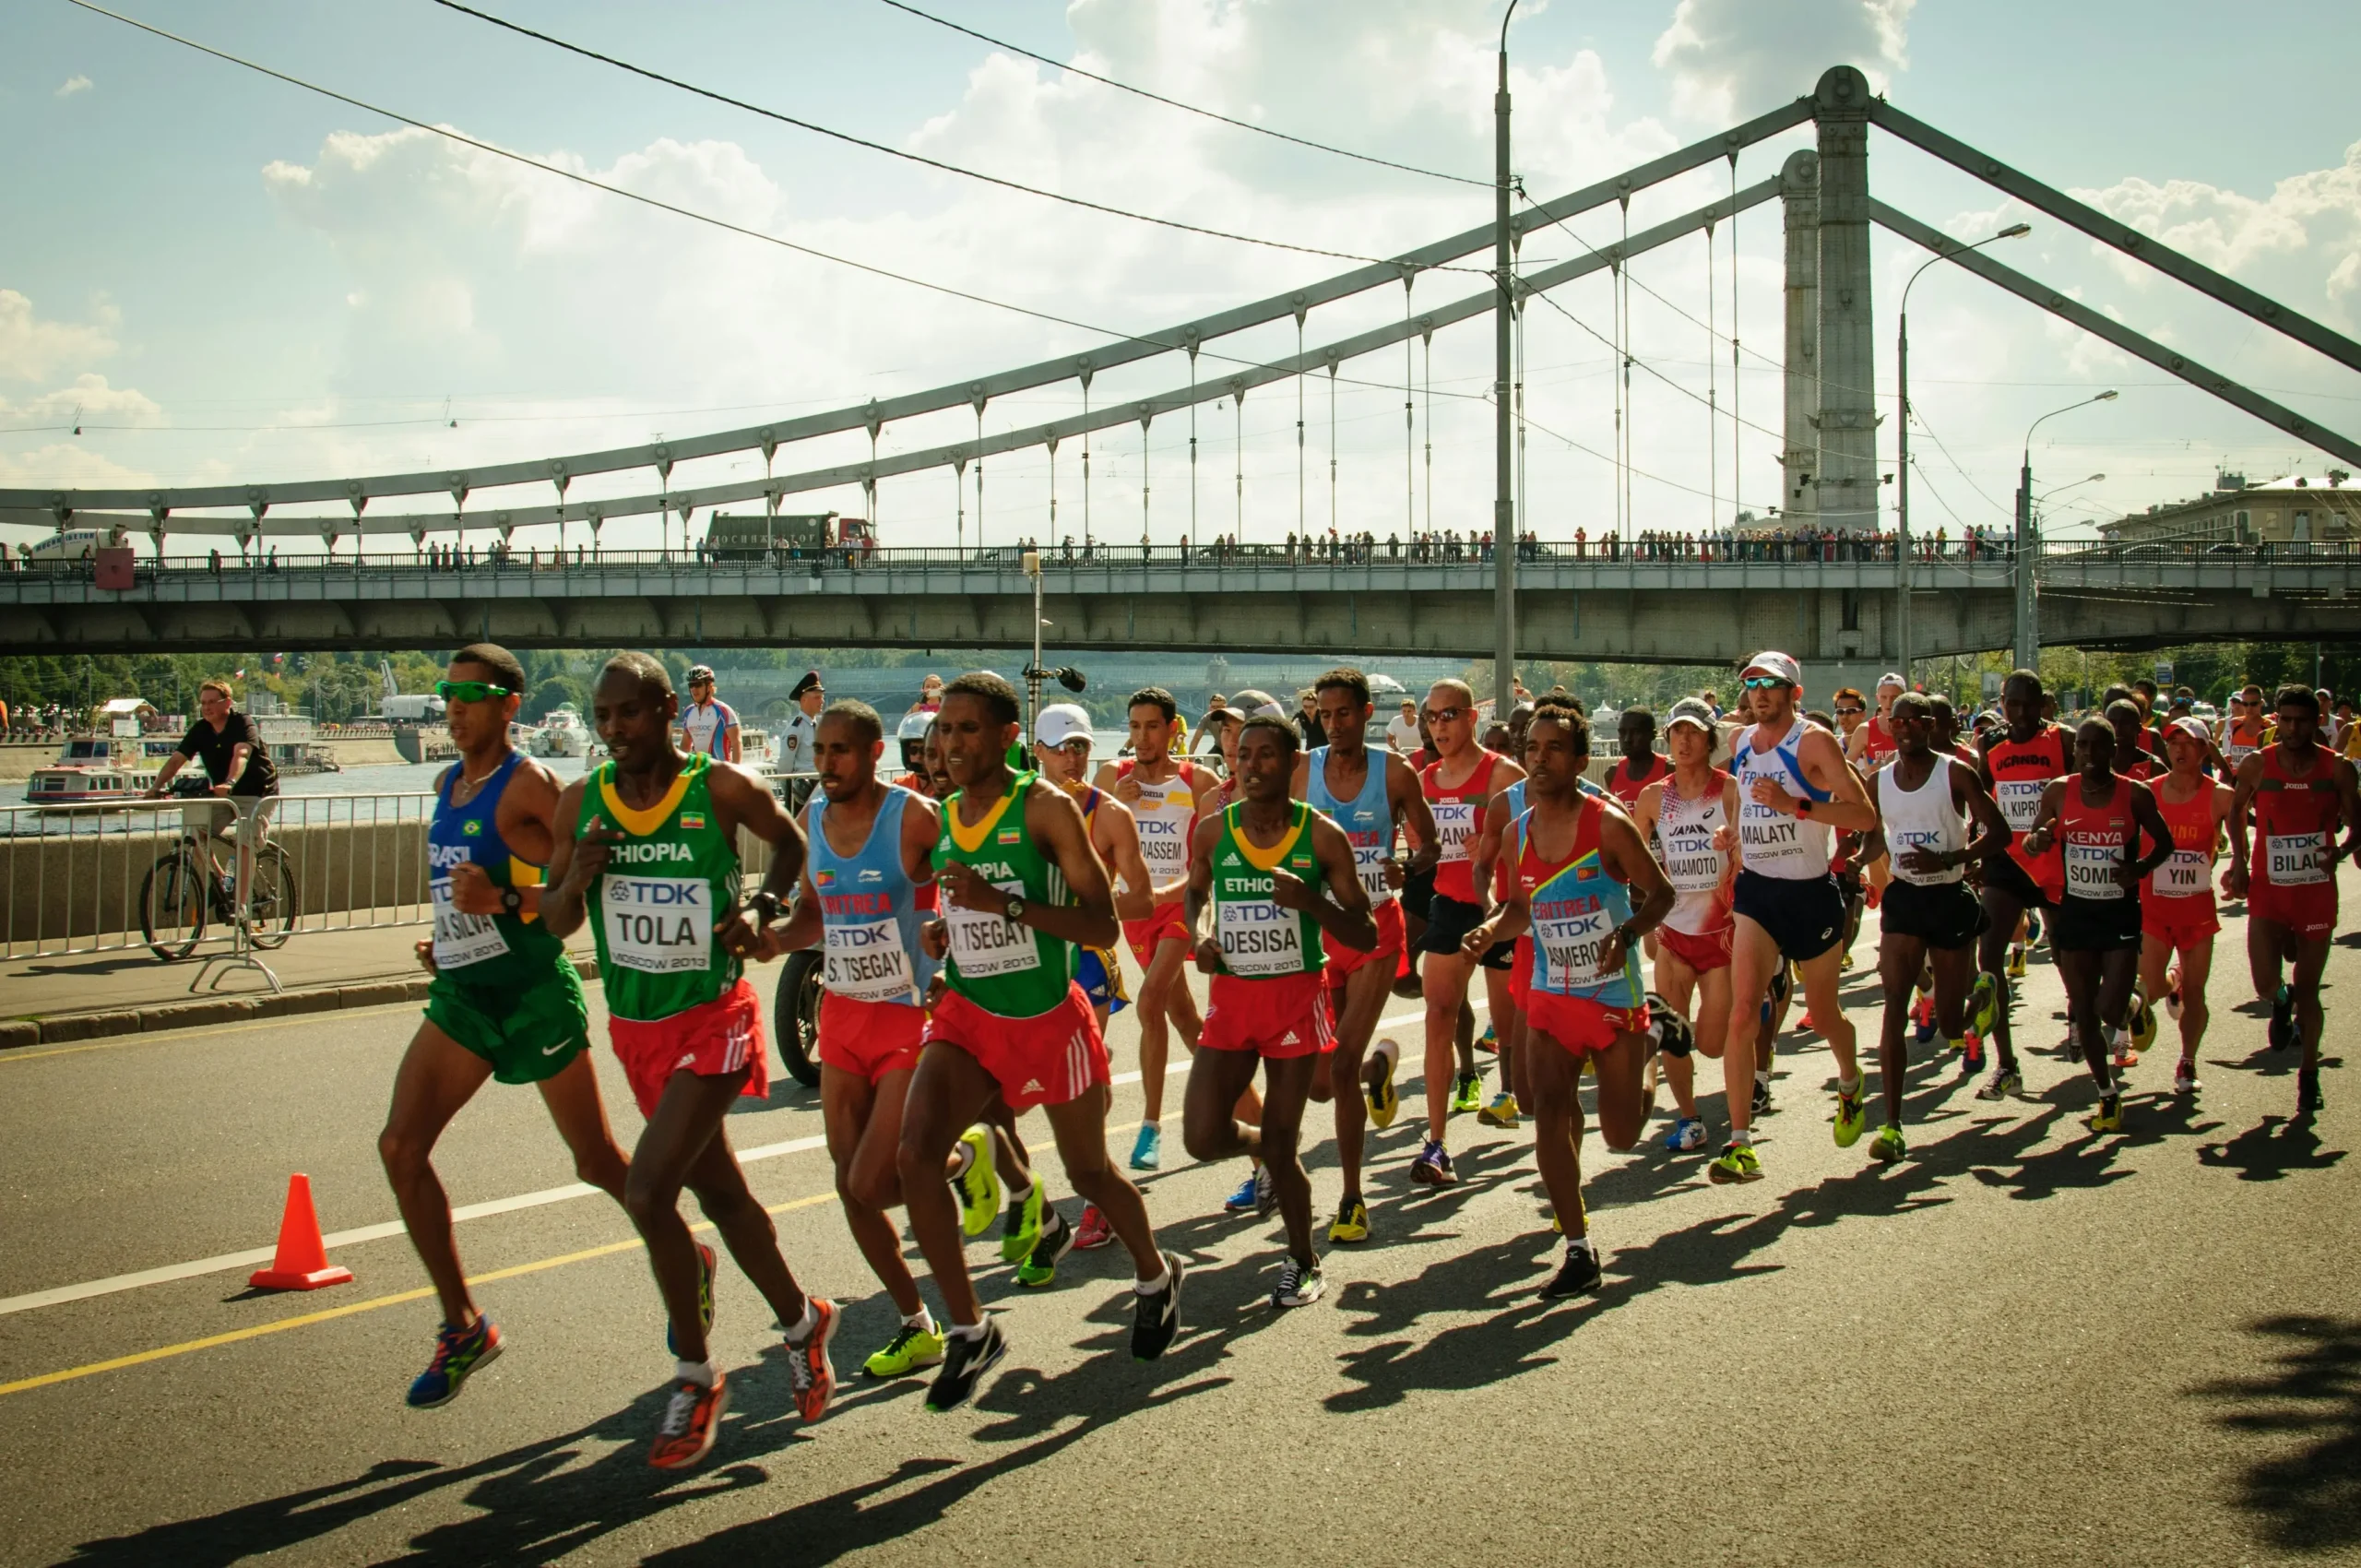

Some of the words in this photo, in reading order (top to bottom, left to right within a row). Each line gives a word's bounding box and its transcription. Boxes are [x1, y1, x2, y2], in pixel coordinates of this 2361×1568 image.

[1996, 754, 2050, 771] UGANDA
[1432, 806, 1467, 820] TDK
[1136, 820, 1177, 835] TDK
[1669, 824, 1710, 837] JAPAN
[1742, 822, 1797, 845] MALATY
[1678, 838, 1713, 852] TDK
[1904, 831, 1940, 845] TDK
[2067, 831, 2122, 844] KENYA
[2283, 835, 2320, 849] TDK
[1745, 850, 1779, 860] OSCOW
[1781, 847, 1804, 856] 2013
[2080, 848, 2118, 861] TDK
[2173, 851, 2205, 864] TDK
[1159, 867, 1180, 875] 2013
[1668, 857, 1717, 876] NAKAMOTO
[1699, 880, 1718, 888] 2013
[2169, 868, 2197, 885] YIN
[1224, 878, 1275, 893] ETHIO
[2069, 886, 2101, 897] MOSCOW
[630, 882, 699, 905] TDK
[1237, 904, 1290, 921] TDK
[1533, 894, 1602, 921] ERITREA
[616, 913, 697, 945] TOLA
[1551, 915, 1603, 938] TDK
[838, 924, 890, 947] TDK
[962, 920, 1027, 952] TSEGAY
[1224, 927, 1299, 954] DESISA
[473, 942, 504, 957] 2013
[1548, 941, 1601, 968] ASMERO
[611, 952, 669, 969] MOSCOW
[670, 957, 707, 968] 2013
[828, 956, 841, 982] S.
[843, 950, 903, 982] TSEGAY
[1003, 955, 1037, 969] 2013
[1273, 959, 1301, 971] 2013
[883, 983, 910, 997] 2013
